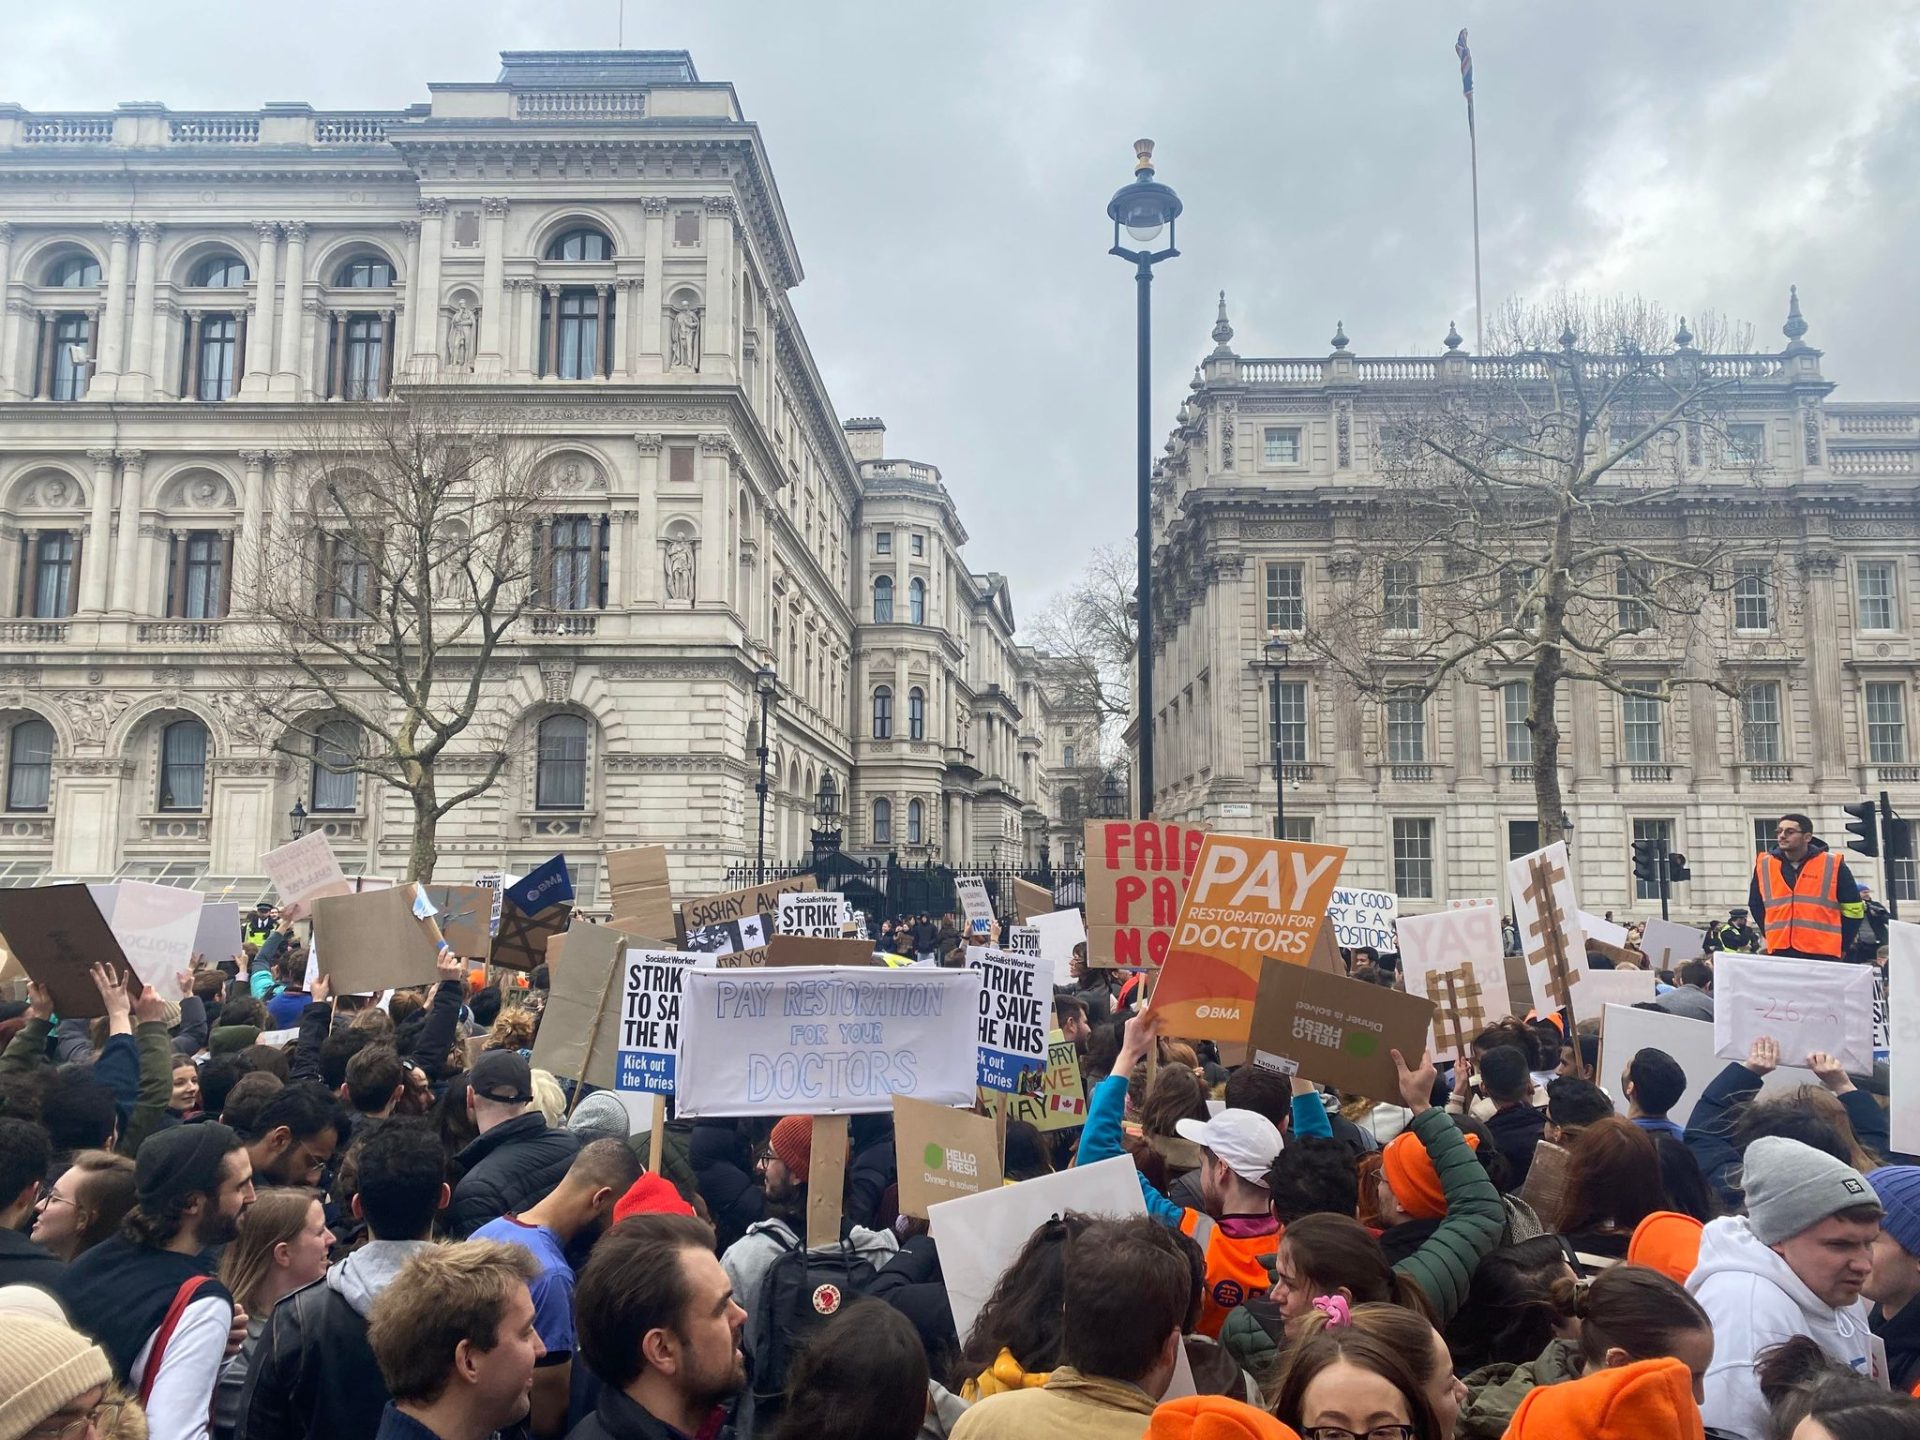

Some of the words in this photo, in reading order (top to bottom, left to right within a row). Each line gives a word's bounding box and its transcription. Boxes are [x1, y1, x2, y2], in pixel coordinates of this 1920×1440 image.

[1194, 844, 1337, 911] PAY
[692, 894, 746, 927] SASHAY
[1115, 875, 1189, 927] PA
[1332, 891, 1359, 905] ONLY
[1361, 892, 1393, 910] GOOD
[783, 905, 837, 928] STRIKE
[972, 918, 991, 932] NHS
[1188, 907, 1286, 927] RESTORATION
[1287, 914, 1316, 929] FOR
[1327, 908, 1348, 921] RY
[1356, 910, 1367, 924] IS
[1373, 912, 1385, 926] A
[1012, 934, 1040, 949] STRIK
[1179, 923, 1310, 954] DOCTORS
[1333, 924, 1396, 950] POSITORY
[629, 964, 683, 993] STRIK
[627, 992, 651, 1019] TO
[657, 994, 680, 1021] SA
[717, 981, 774, 1019] PAY
[784, 980, 944, 1017] RESTORATION
[980, 989, 990, 1016] O
[996, 994, 1043, 1026] SAVE
[1296, 1001, 1333, 1016] solved
[1210, 1008, 1240, 1020] BMA
[1334, 1011, 1344, 1021] is
[1346, 1015, 1383, 1033] Dinner
[624, 1020, 659, 1048] THE
[790, 1024, 828, 1046] FOR
[839, 1022, 883, 1044] YOUR
[978, 1017, 999, 1045] HE
[1004, 1023, 1044, 1055] NHS
[1293, 1016, 1342, 1038] FRESH
[1292, 1027, 1341, 1050] HELLO
[624, 1054, 647, 1071] Kick
[650, 1058, 666, 1072] out
[989, 1056, 1005, 1070] out
[1048, 1044, 1074, 1066] PAY
[622, 1072, 640, 1087] the
[644, 1073, 674, 1091] Tories
[748, 1050, 918, 1102] DOCTORS
[983, 1068, 1013, 1089] Tories
[946, 1147, 976, 1165] HELLO
[947, 1160, 977, 1177] FRESH
[924, 1172, 948, 1186] Dinner
[949, 1180, 956, 1188] is
[956, 1181, 979, 1193] solved
